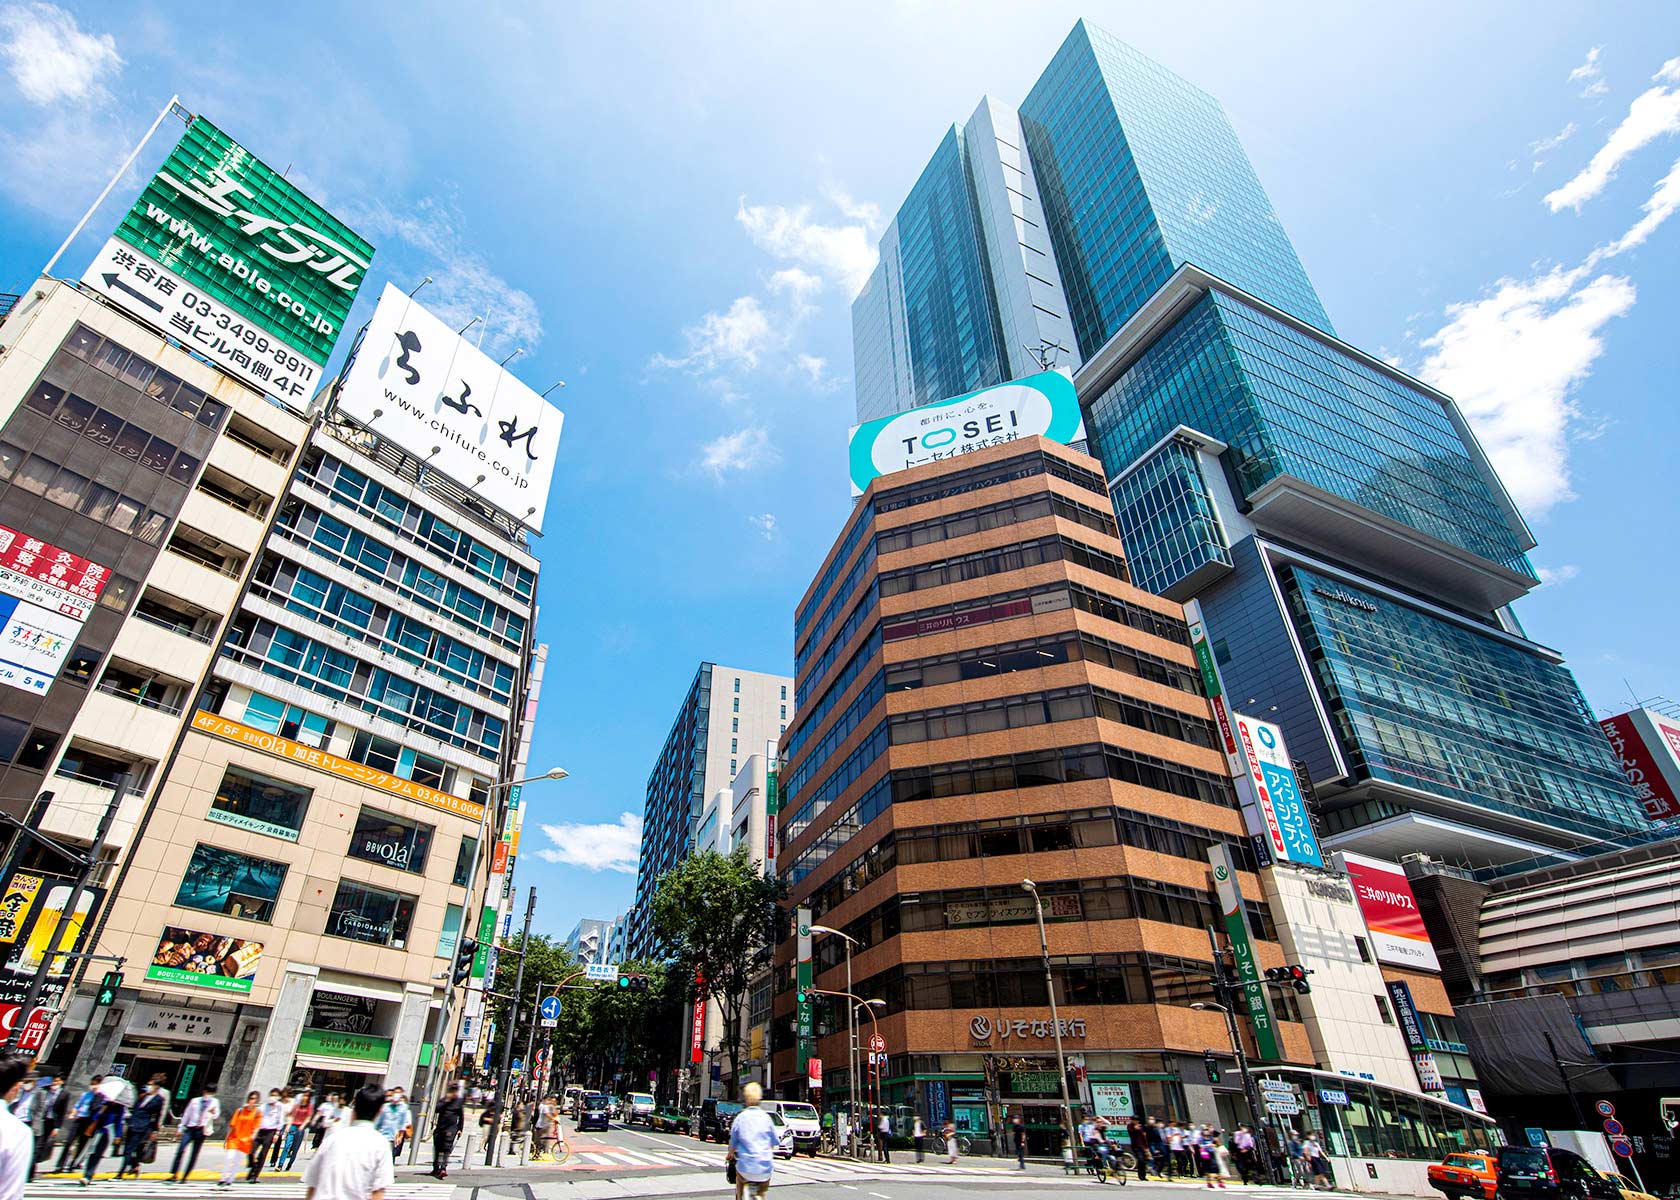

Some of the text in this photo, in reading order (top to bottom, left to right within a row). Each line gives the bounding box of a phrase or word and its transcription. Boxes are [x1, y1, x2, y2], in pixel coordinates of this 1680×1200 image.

[156, 168, 371, 291] エイブル
[146, 202, 334, 336] www.able.co.jp
[111, 248, 313, 382] 渋谷店 03-3499-8911
[394, 330, 538, 460] ちふれ
[384, 387, 528, 490] www.chifure.co.jp
[902, 410, 1018, 455] TOSEI
[904, 431, 1020, 469] トーセイ株式会社
[1015, 467, 1036, 480] 11F
[416, 788, 486, 816] 03.6418.0064
[511, 787, 520, 807] NOVA
[1267, 770, 1302, 854] アイシティ
[1281, 774, 1314, 857] コンタクトの
[1358, 884, 1415, 910] 三井のリハウス
[316, 992, 360, 1004] BOULANGERIE
[1236, 943, 1268, 1029] りそな銀行
[21, 1028, 44, 1047] 円
[997, 1018, 1086, 1039] りそな銀行
